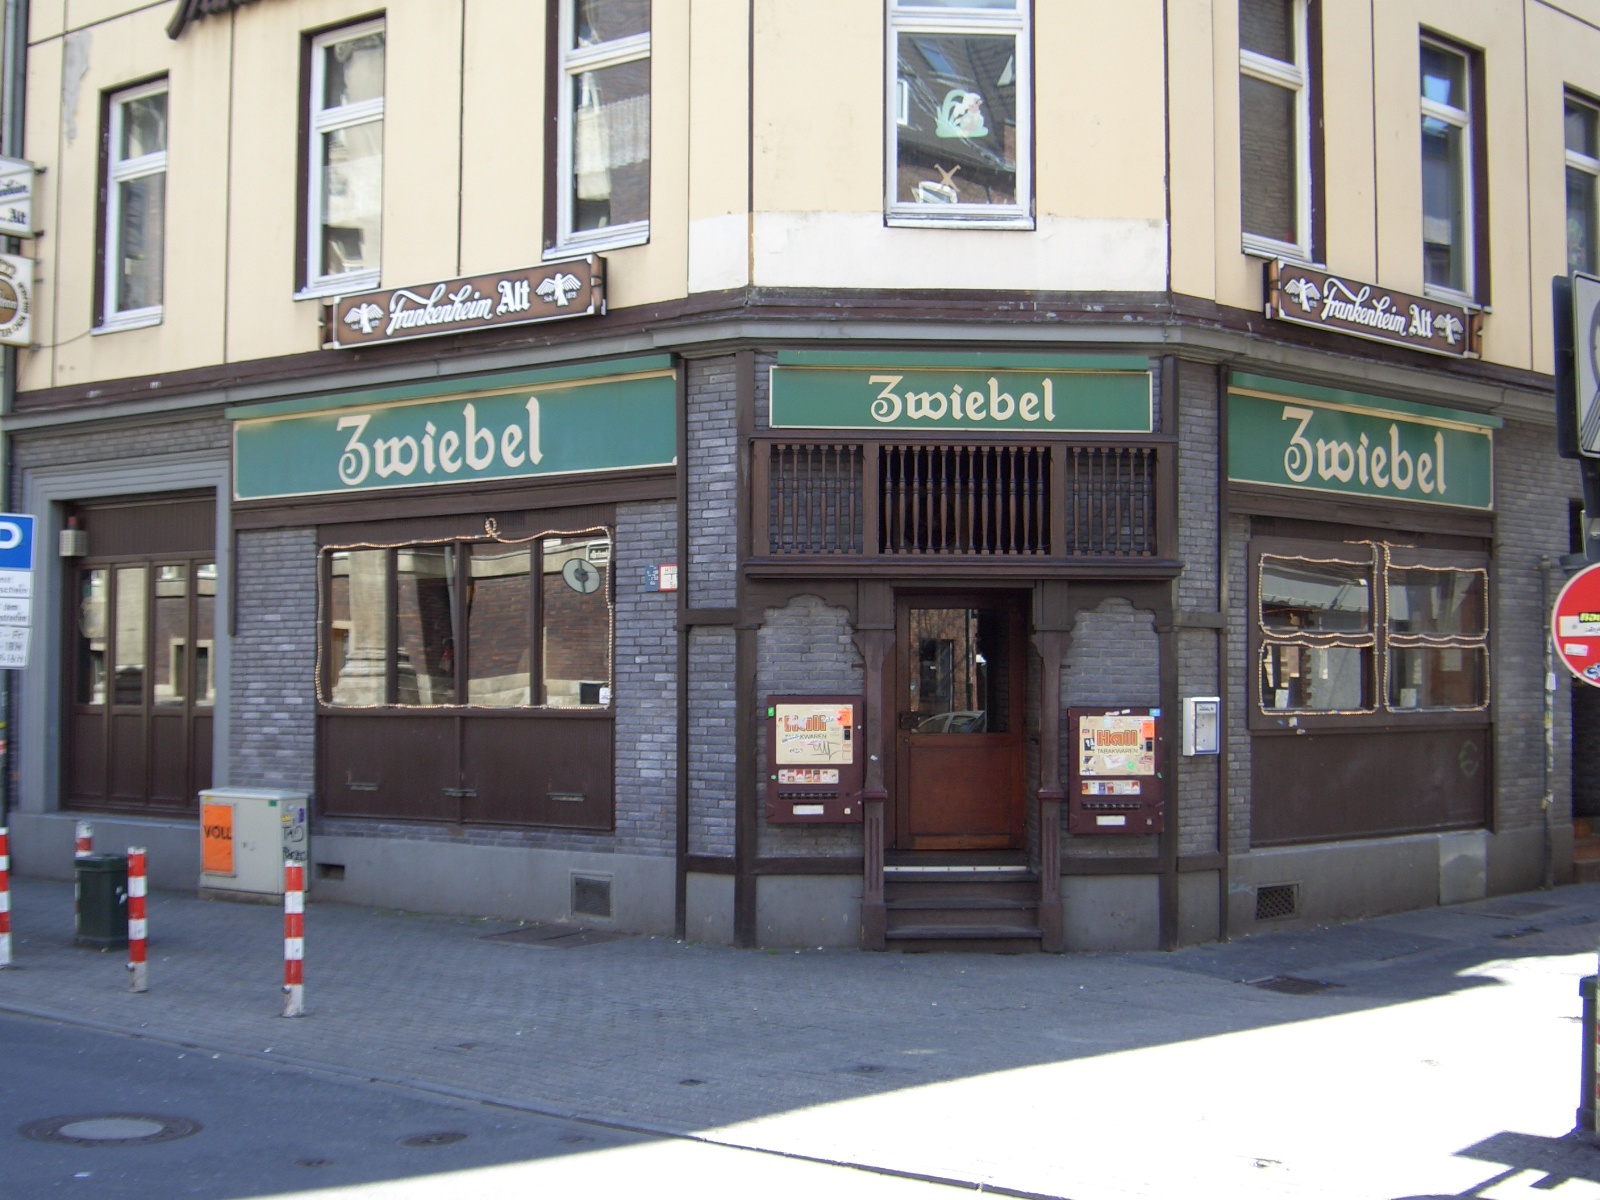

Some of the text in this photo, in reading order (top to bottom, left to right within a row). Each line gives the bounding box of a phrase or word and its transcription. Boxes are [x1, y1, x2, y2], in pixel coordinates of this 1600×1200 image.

[386, 279, 531, 336] Frankenheim Alt
[1321, 277, 1433, 338] Frankenheim Alt
[868, 375, 1056, 423] Zwiebel
[336, 396, 544, 486] Zwiebel
[1281, 406, 1447, 495] Zwiebel
[1096, 729, 1138, 747] Hall
[204, 825, 232, 840] VOLL
